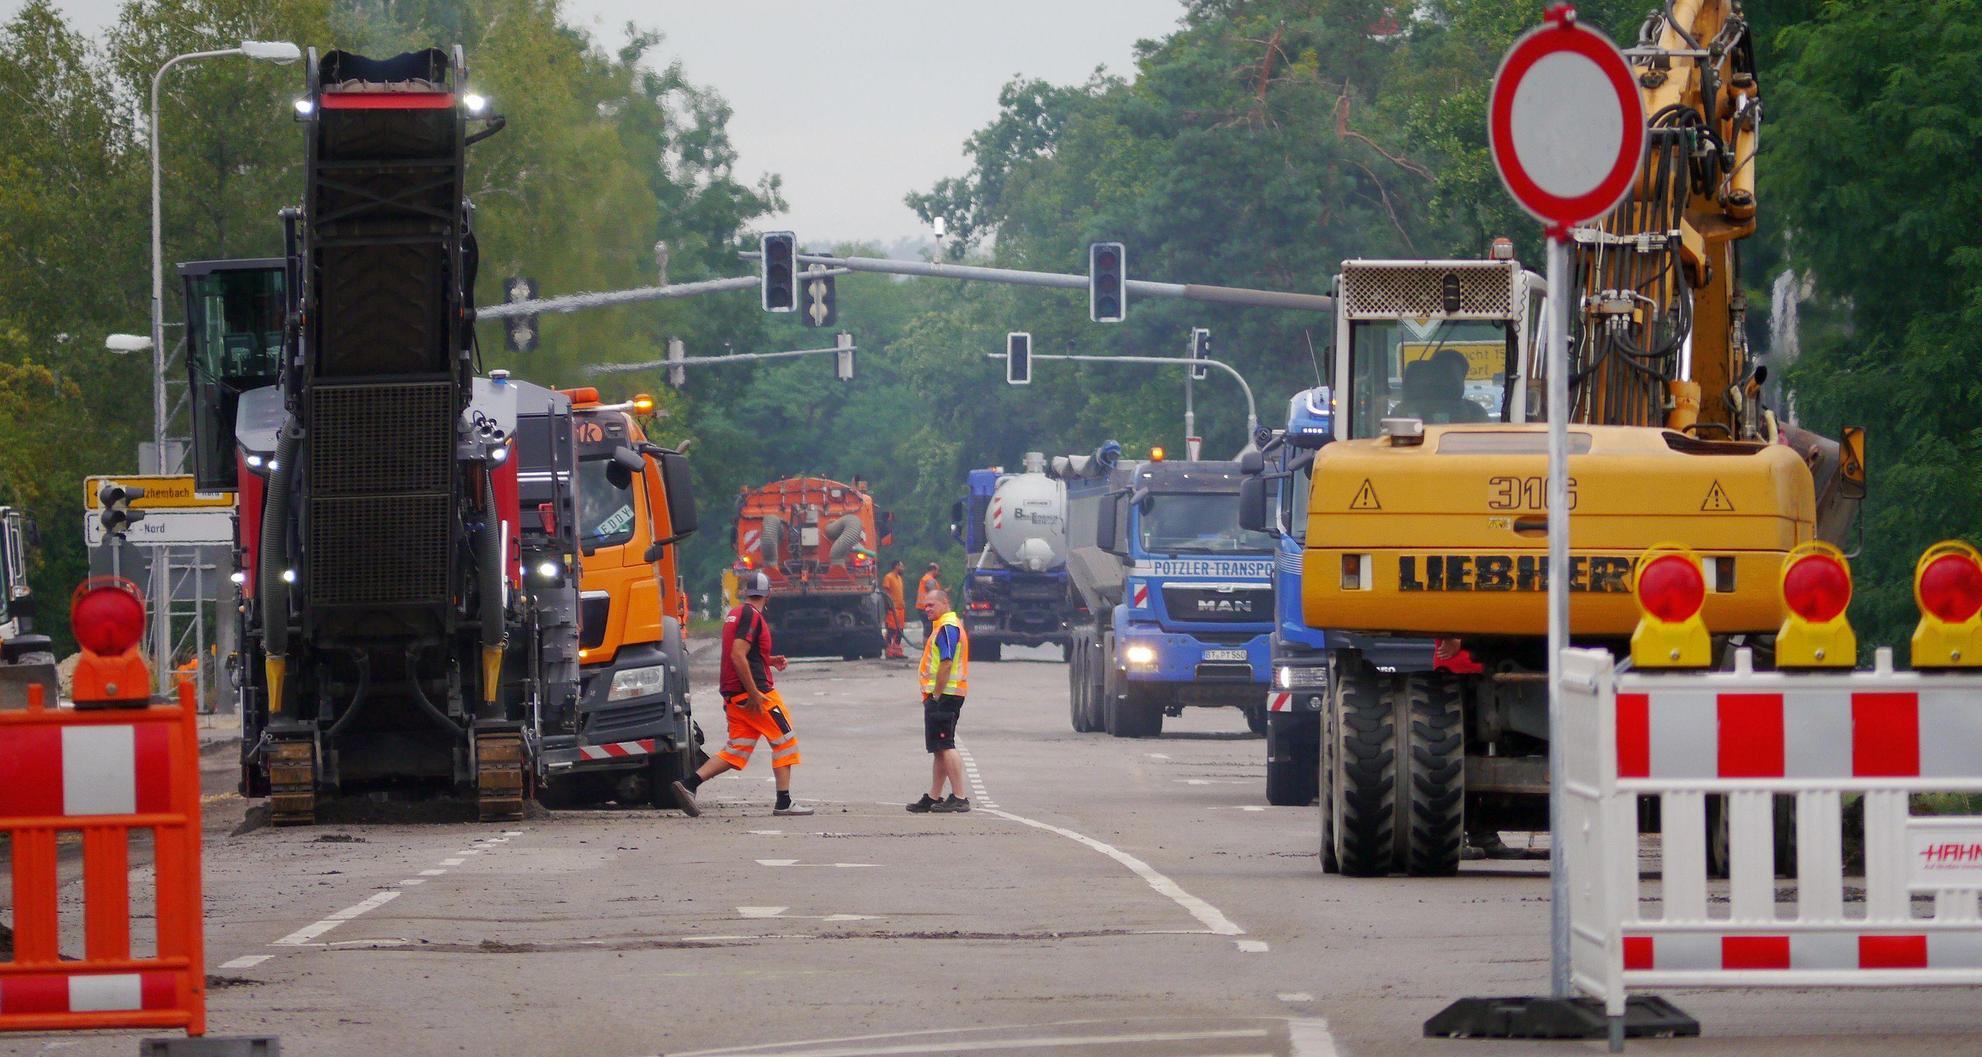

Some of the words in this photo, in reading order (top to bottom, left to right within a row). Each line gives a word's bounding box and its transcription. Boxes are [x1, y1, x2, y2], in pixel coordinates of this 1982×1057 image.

[601, 507, 632, 535] EDDY
[1154, 561, 1273, 576] POTZLER-TRANSPO
[1399, 555, 1638, 592] LIEBHER
[1198, 600, 1251, 612] MAN
